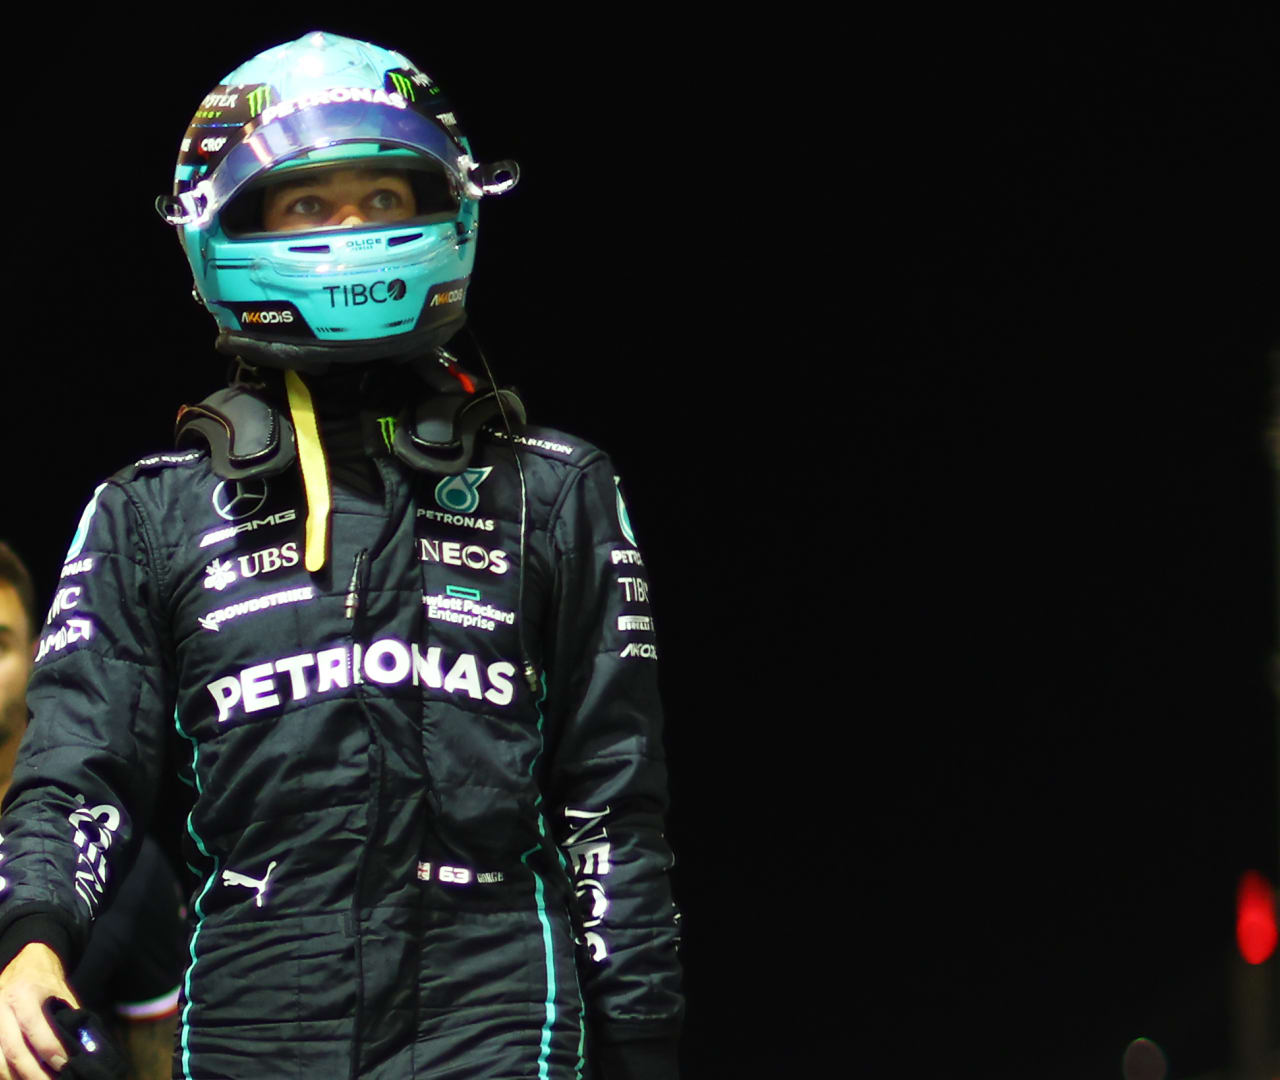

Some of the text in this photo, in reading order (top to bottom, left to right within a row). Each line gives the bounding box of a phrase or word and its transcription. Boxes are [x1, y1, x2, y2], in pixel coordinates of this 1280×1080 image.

[345, 238, 382, 247] OLICE
[234, 509, 297, 534] AMG
[417, 508, 495, 532] PETRONAS
[237, 542, 299, 578] UBS
[415, 537, 510, 575] NEOS
[427, 604, 496, 632] Enterprise
[463, 599, 515, 625] Packard
[206, 638, 516, 723] PETRONAS
[438, 865, 470, 884] 63
